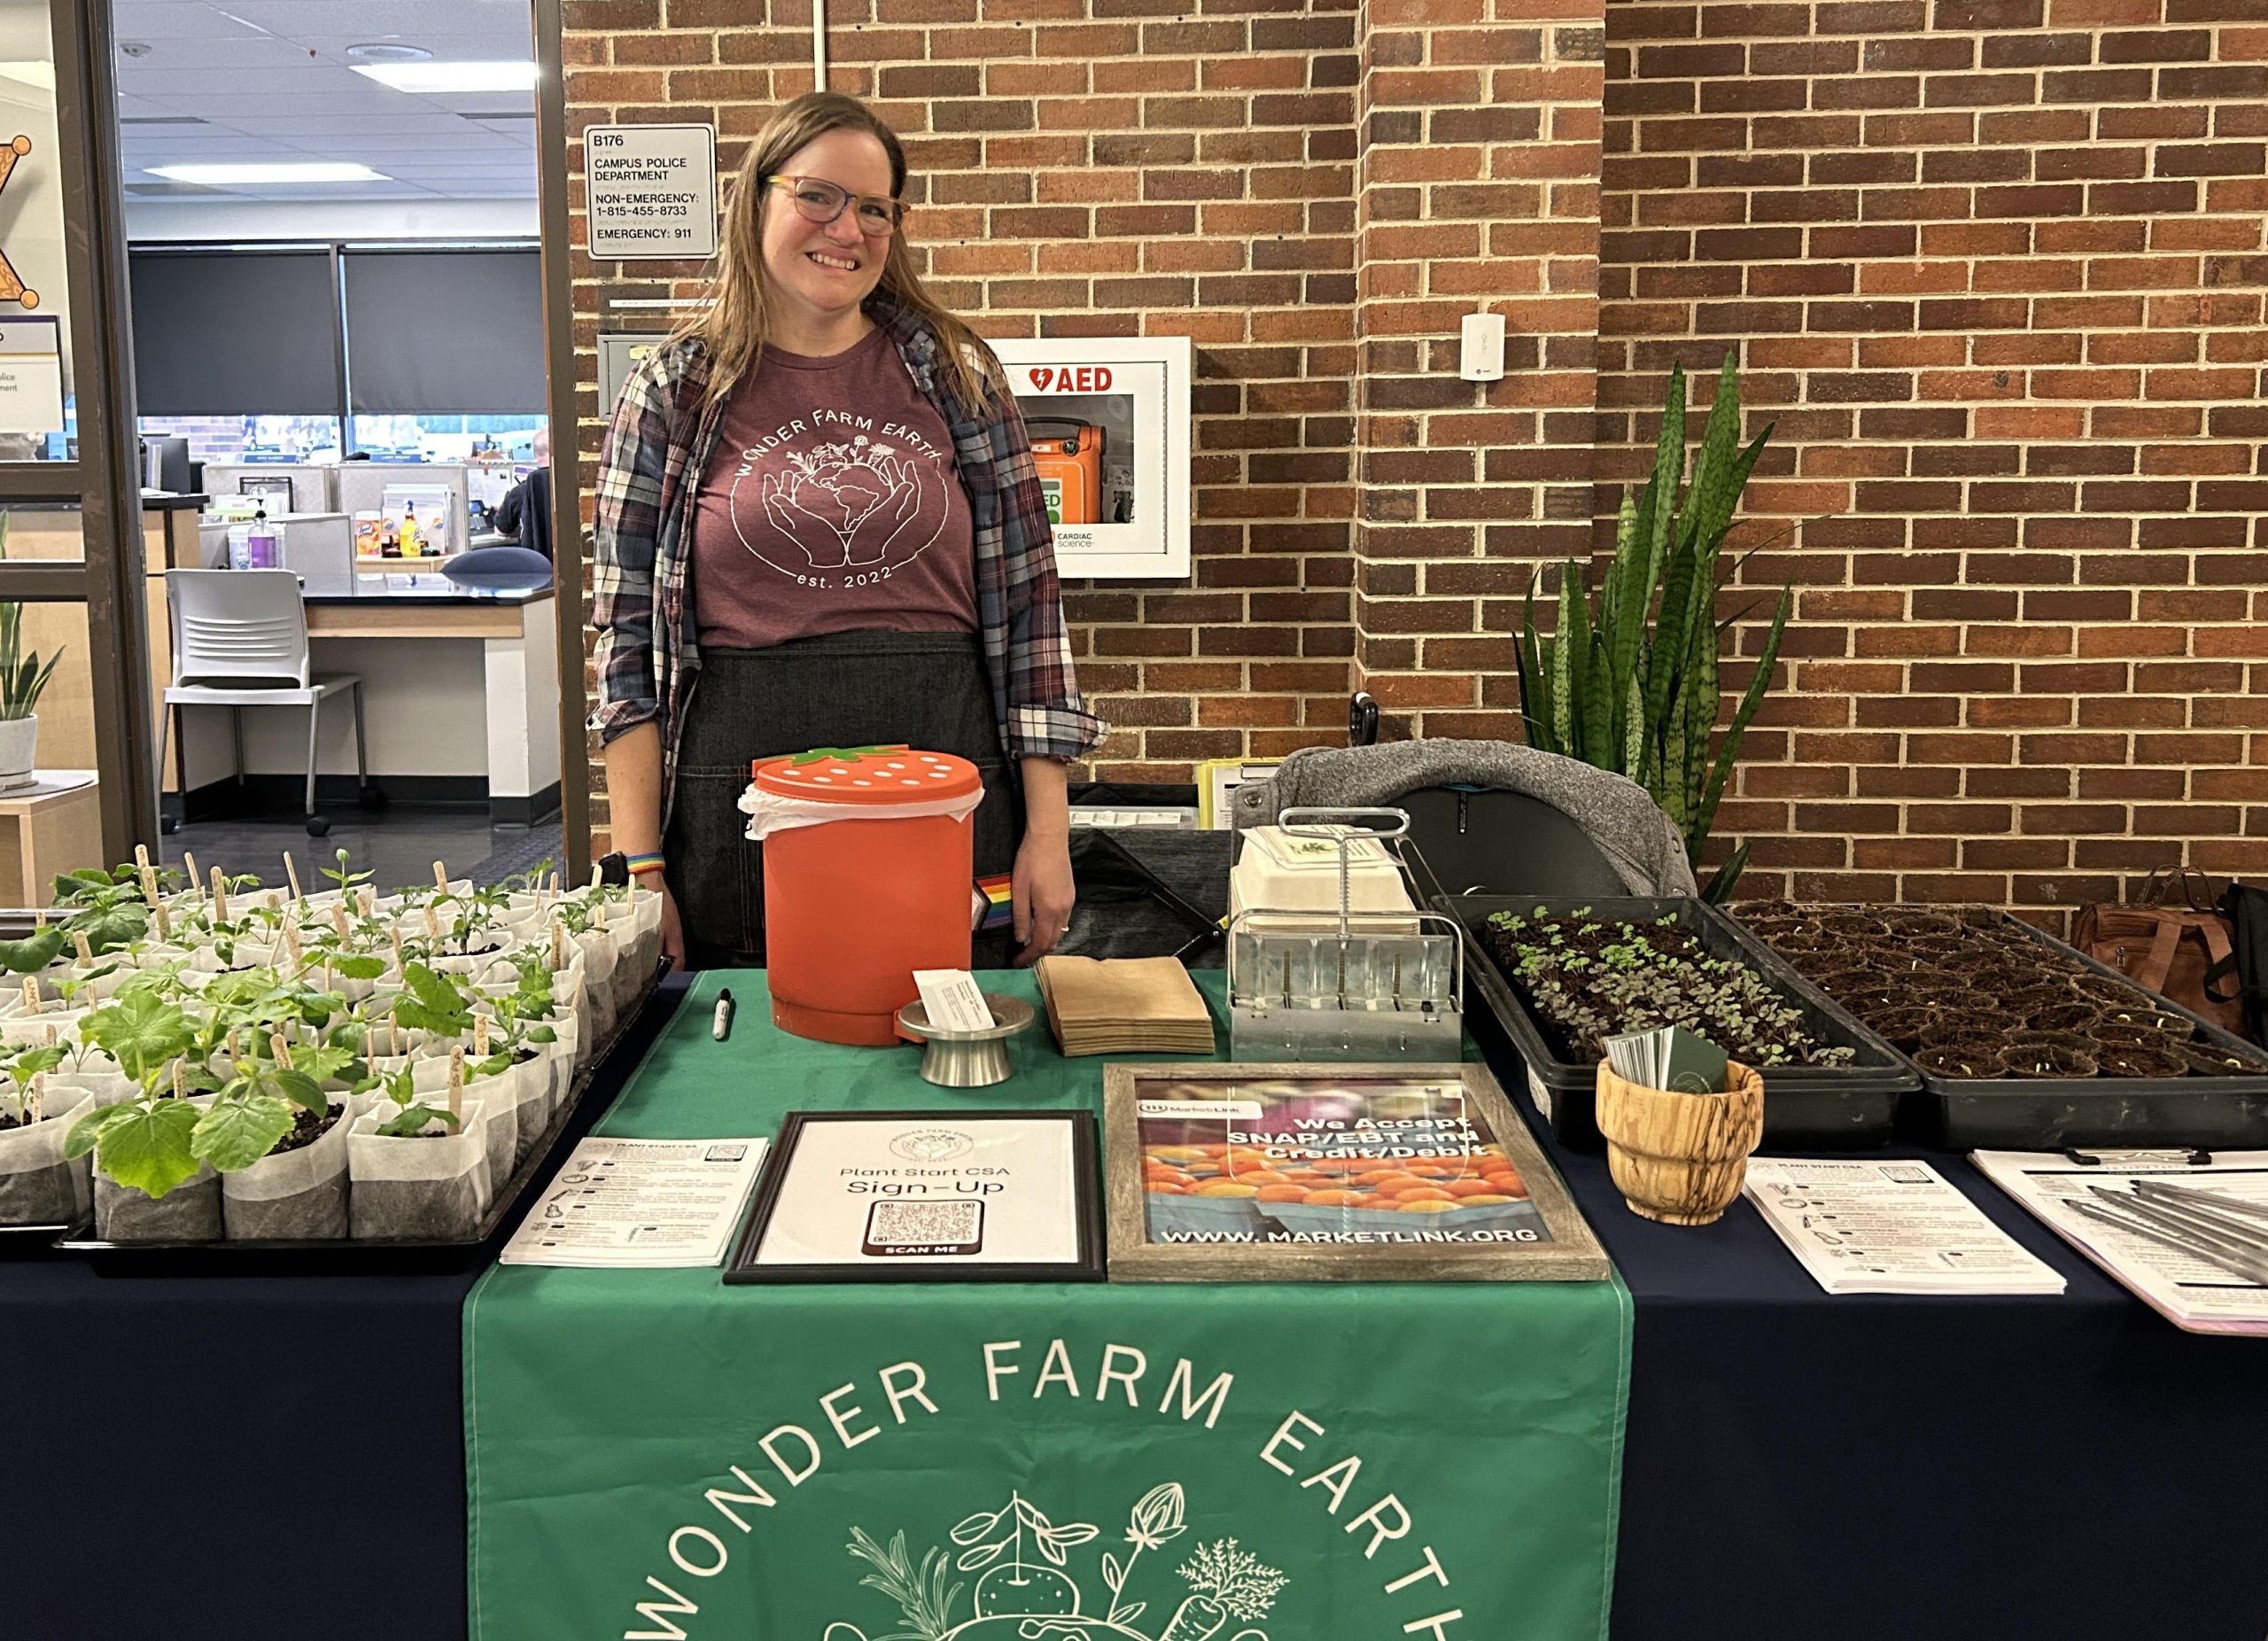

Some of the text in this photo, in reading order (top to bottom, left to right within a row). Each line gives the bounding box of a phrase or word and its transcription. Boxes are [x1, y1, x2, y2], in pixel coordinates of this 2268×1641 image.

[594, 135, 624, 146] B176
[594, 158, 687, 168] CAMPUS POLICE
[594, 171, 669, 181] DEPARTMENT
[595, 193, 699, 204] NON-EMERGENCY:
[596, 206, 687, 216] 1-815-455-8733
[597, 229, 691, 238] EMERGENCY: 911
[1055, 367, 1113, 393] AED
[734, 408, 944, 478] WONDER FARM EARTH
[1043, 494, 1060, 507] ED
[797, 566, 891, 588] est. 2022
[1293, 1116, 1472, 1132] We Accept
[1227, 1130, 1480, 1145] SNAP/EBT and
[1263, 1145, 1489, 1159] Credit/Debit
[840, 1168, 897, 1177] Plant
[905, 1168, 959, 1177] Start
[847, 1181, 1005, 1196] Sign-Up
[1161, 1230, 1539, 1243] WWW. MARKETLINK.ORG
[624, 1338, 1466, 1641] WONDER FARM EARTH
